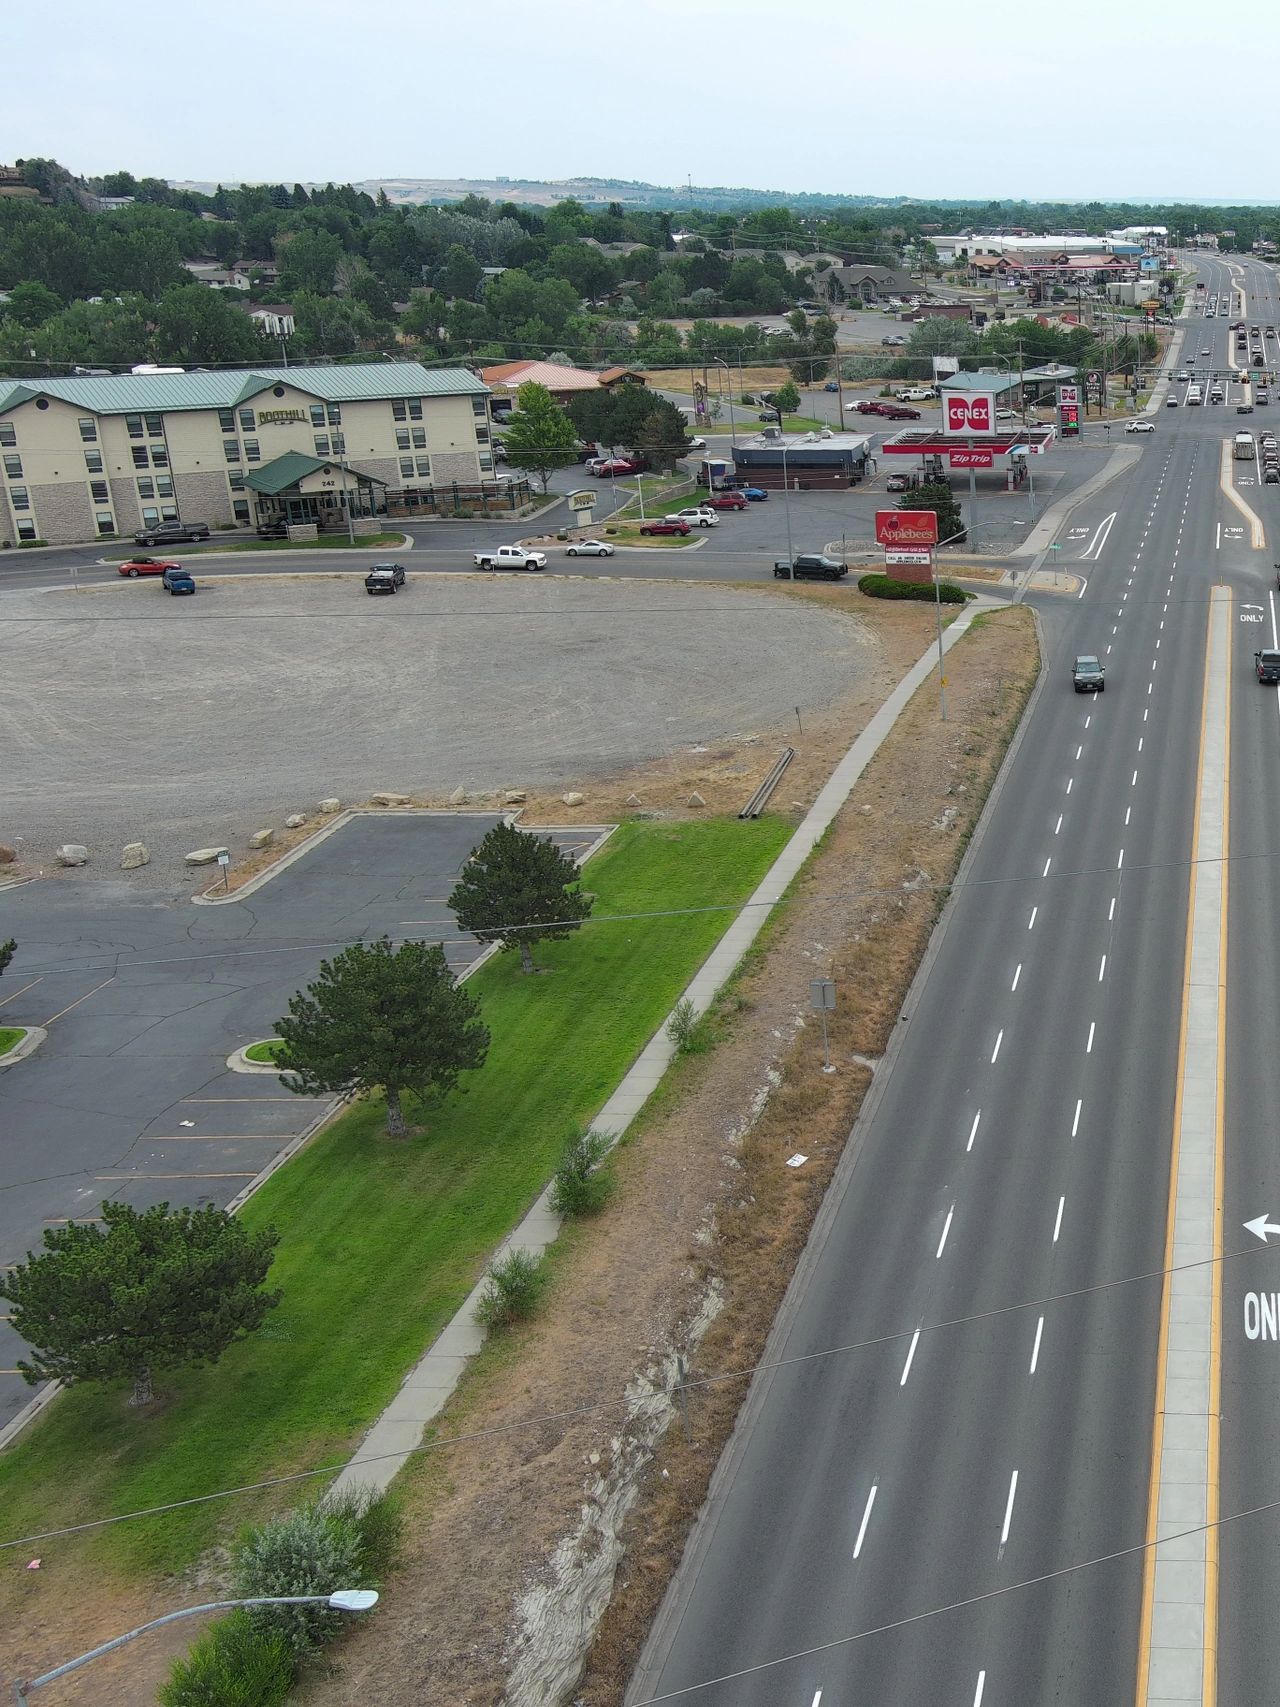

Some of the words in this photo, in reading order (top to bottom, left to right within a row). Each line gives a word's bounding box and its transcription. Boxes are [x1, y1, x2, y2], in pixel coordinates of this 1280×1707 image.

[950, 408, 987, 419] CENEX
[951, 454, 969, 462] Zip
[971, 454, 990, 462] Trip
[880, 526, 933, 540] Applebee's
[1240, 614, 1264, 622] ONLY
